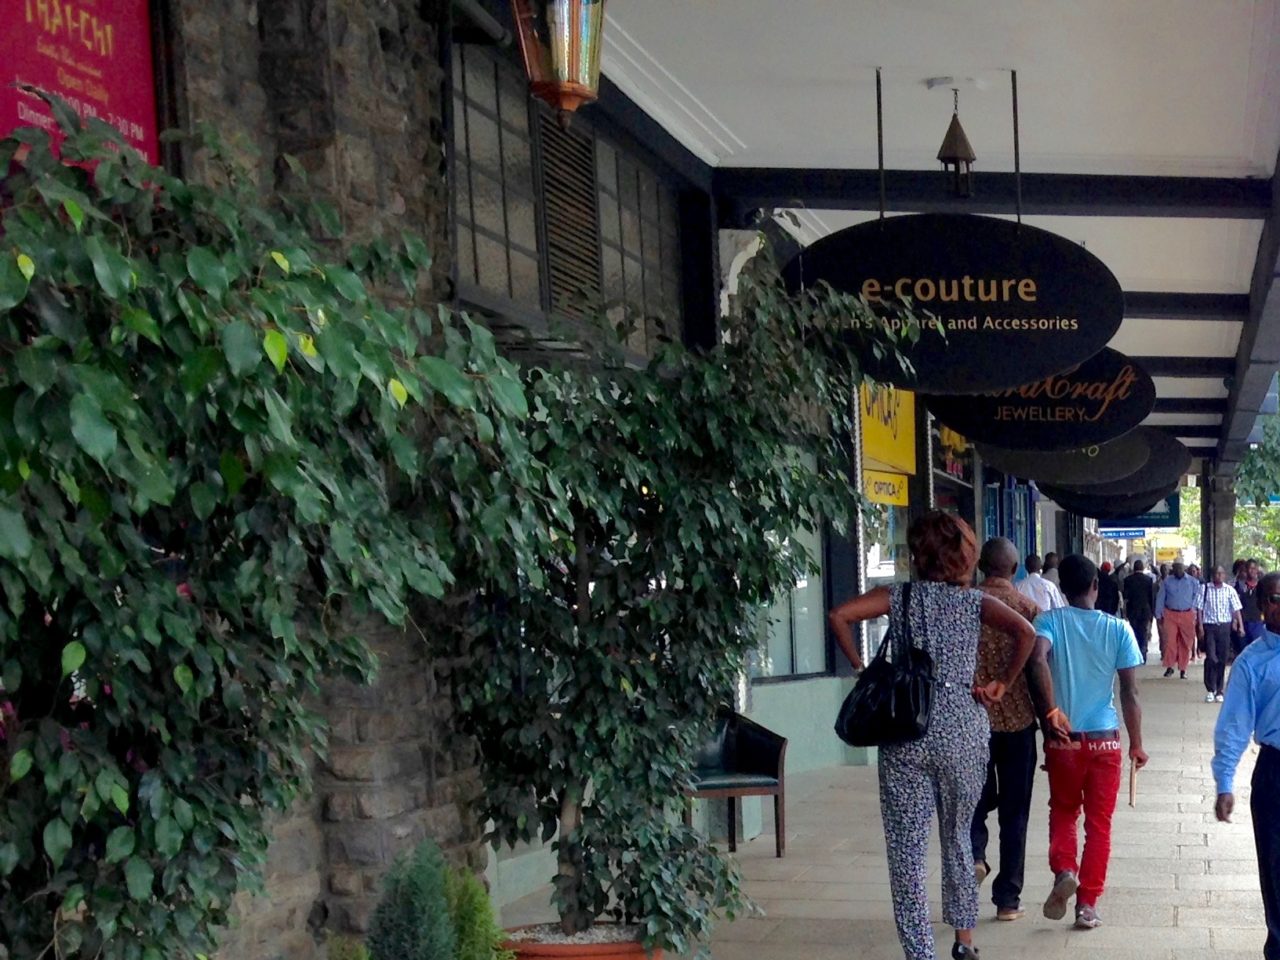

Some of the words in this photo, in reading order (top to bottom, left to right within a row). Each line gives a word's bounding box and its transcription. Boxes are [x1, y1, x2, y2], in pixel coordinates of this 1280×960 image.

[861, 274, 1037, 302] e-couture
[947, 316, 978, 330] and
[982, 315, 1079, 330] Accessories
[993, 405, 1087, 423] JEWELLERY
